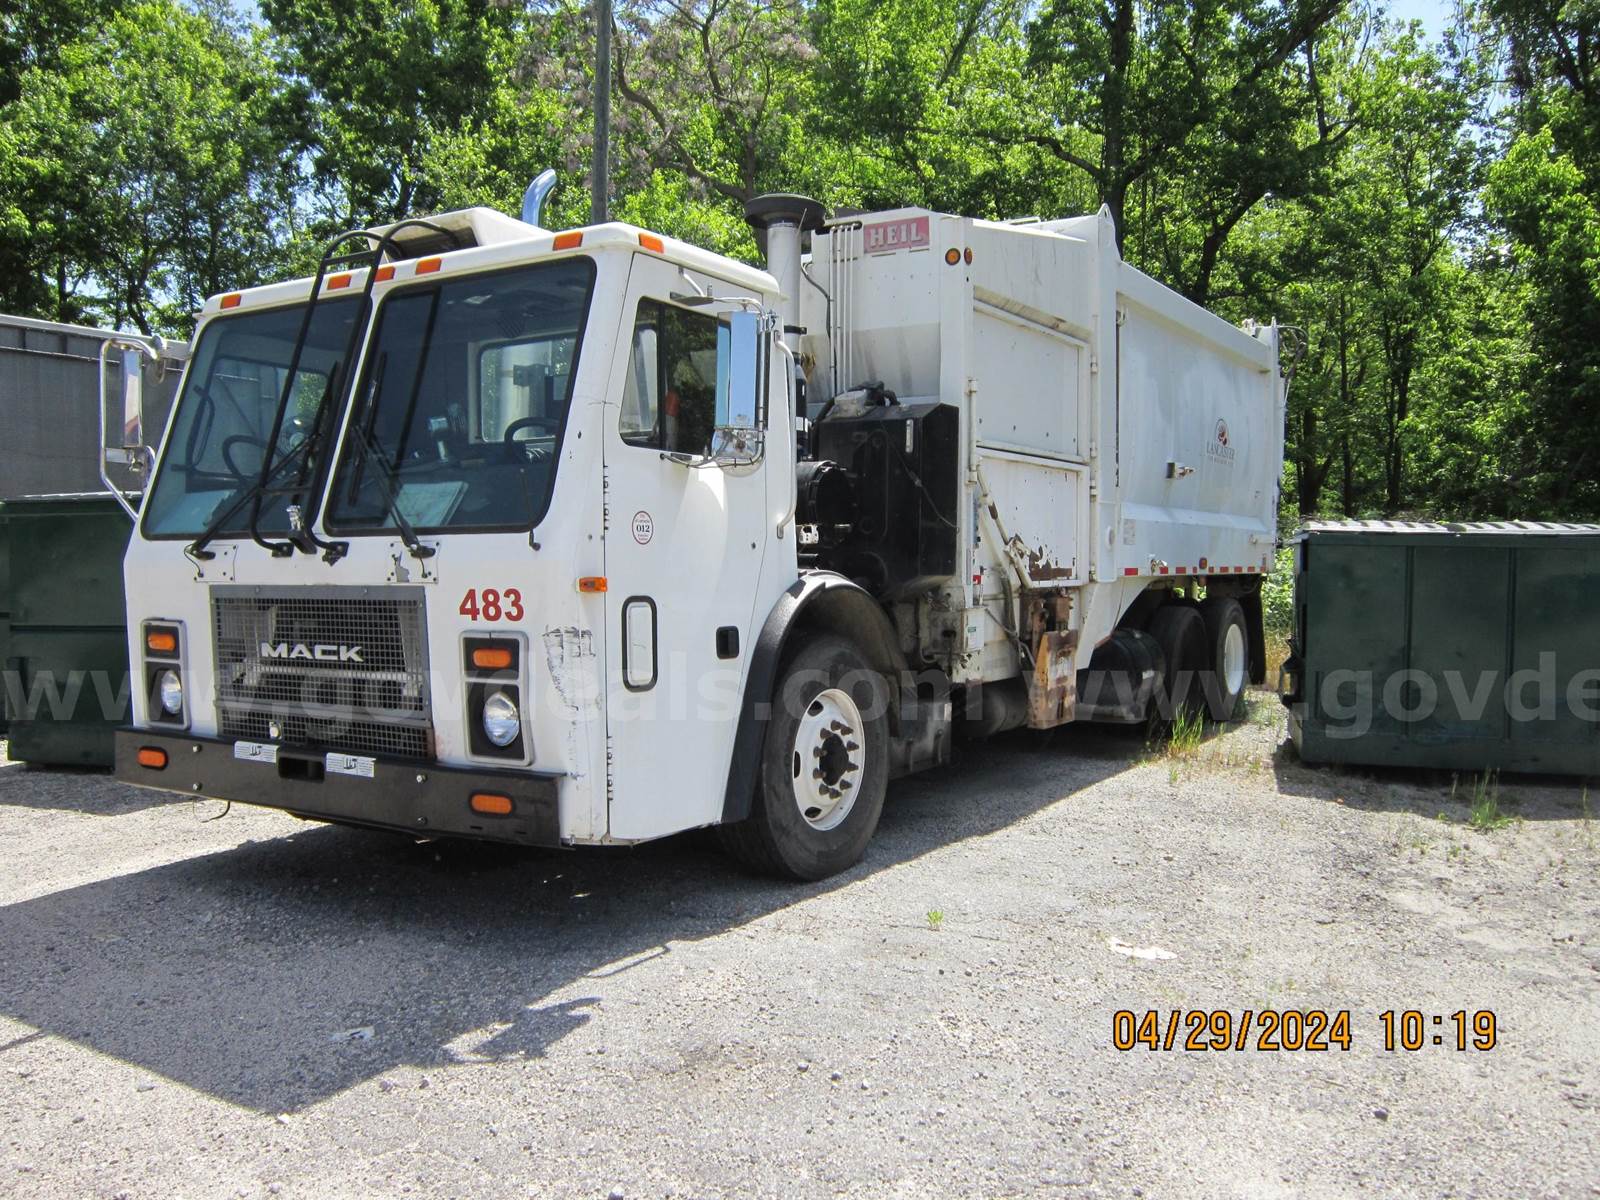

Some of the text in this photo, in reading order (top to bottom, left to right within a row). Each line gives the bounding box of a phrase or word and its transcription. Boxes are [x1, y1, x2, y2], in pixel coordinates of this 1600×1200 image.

[869, 222, 922, 247] HEIL
[1206, 441, 1236, 460] LANCASTER
[636, 524, 650, 533] 012
[459, 588, 524, 622] 483
[261, 642, 364, 663] MACK
